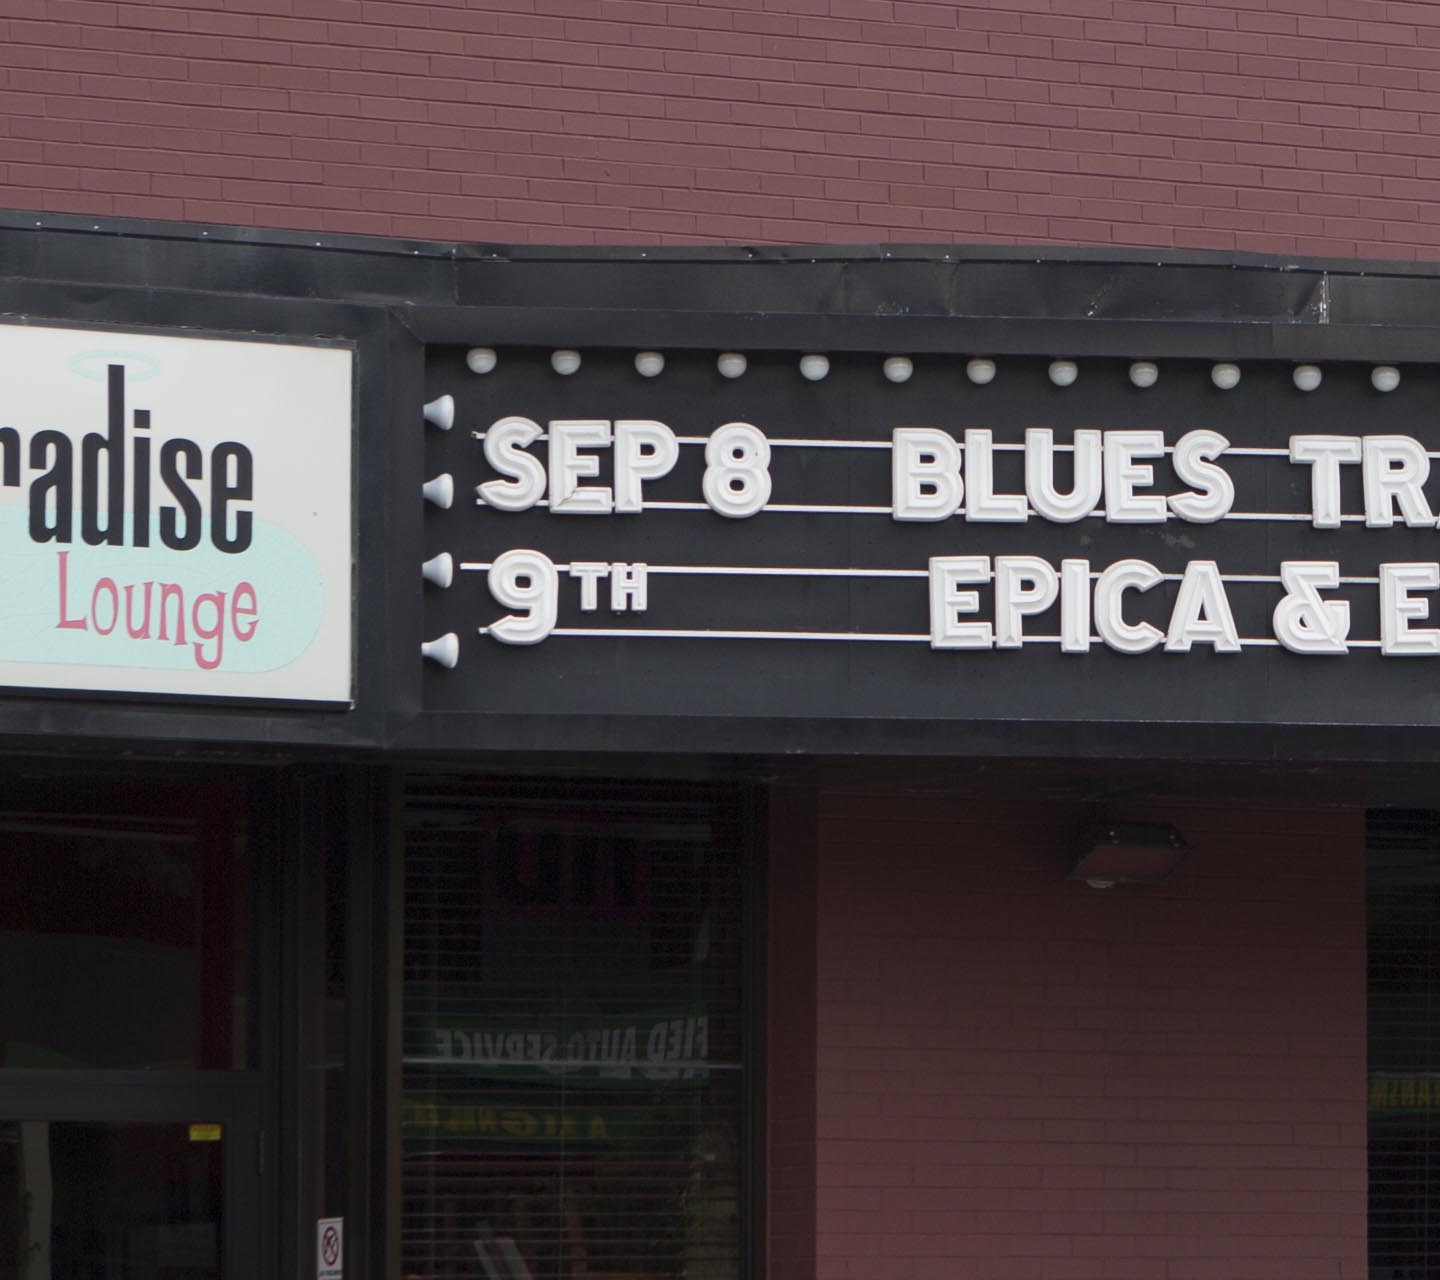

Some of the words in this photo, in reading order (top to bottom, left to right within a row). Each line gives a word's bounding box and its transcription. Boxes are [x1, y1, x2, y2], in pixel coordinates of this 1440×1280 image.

[476, 416, 679, 515] SEP
[702, 422, 773, 519] 8
[892, 427, 1236, 524] BLUES
[56, 551, 260, 670] Lounge
[485, 548, 649, 645] 9TH
[928, 555, 1242, 656] EPICA
[1273, 560, 1351, 656] &
